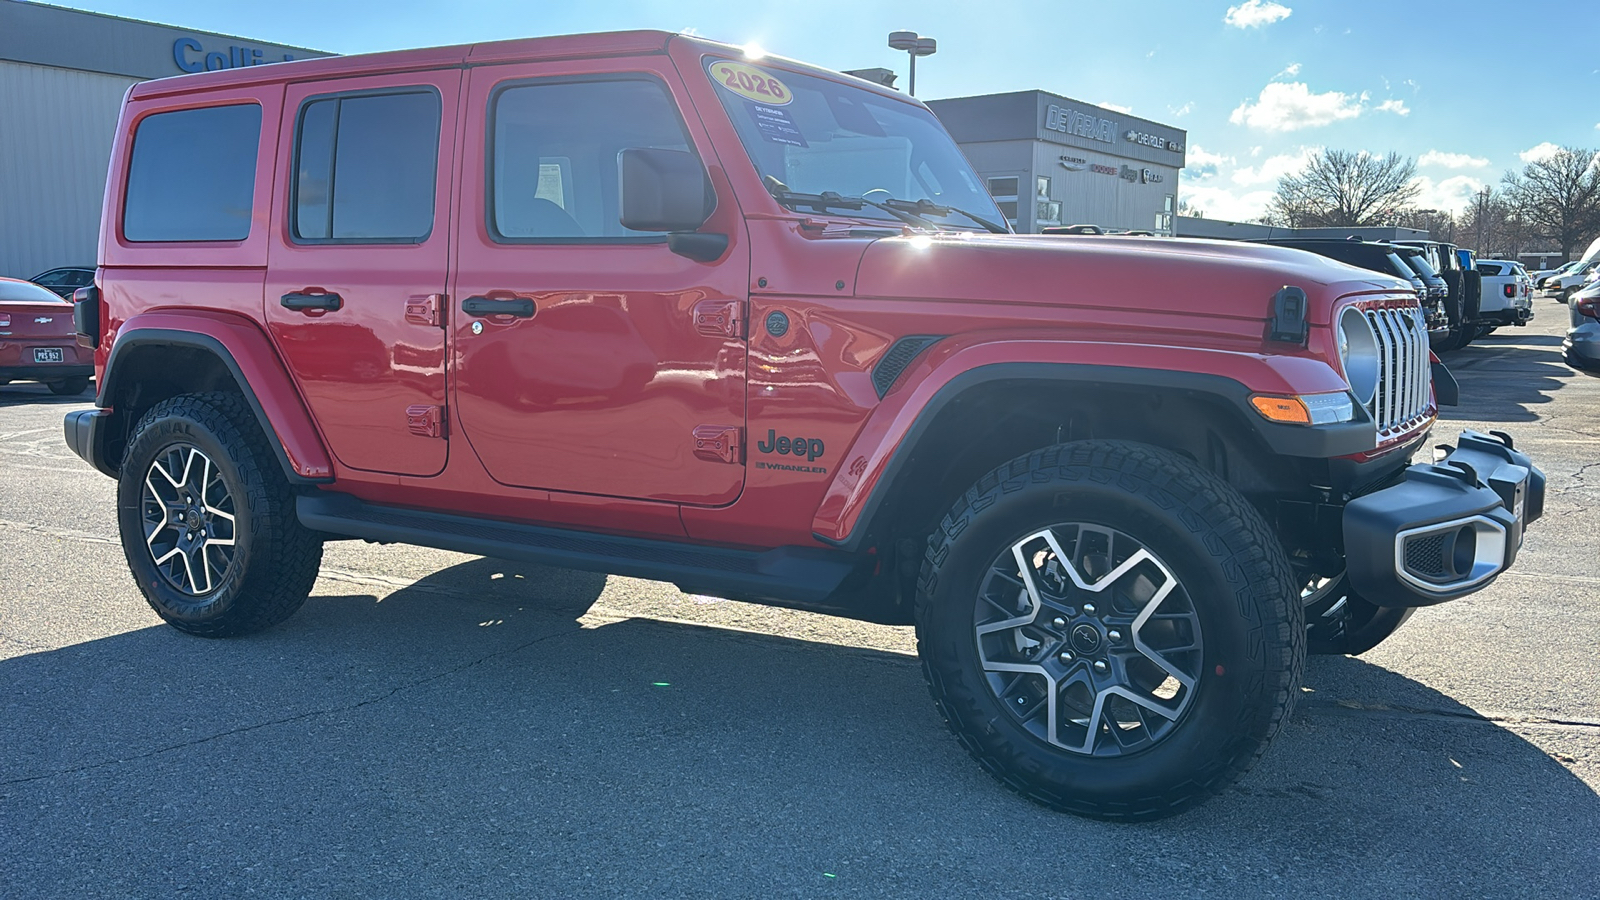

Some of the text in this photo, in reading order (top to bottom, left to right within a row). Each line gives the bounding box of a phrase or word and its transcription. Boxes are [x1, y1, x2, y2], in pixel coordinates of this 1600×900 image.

[173, 37, 294, 73] Colli
[721, 67, 785, 99] 2026
[1045, 104, 1119, 144] DEYARMAN
[757, 429, 825, 462] Jeep
[766, 462, 827, 474] WRANGLER
